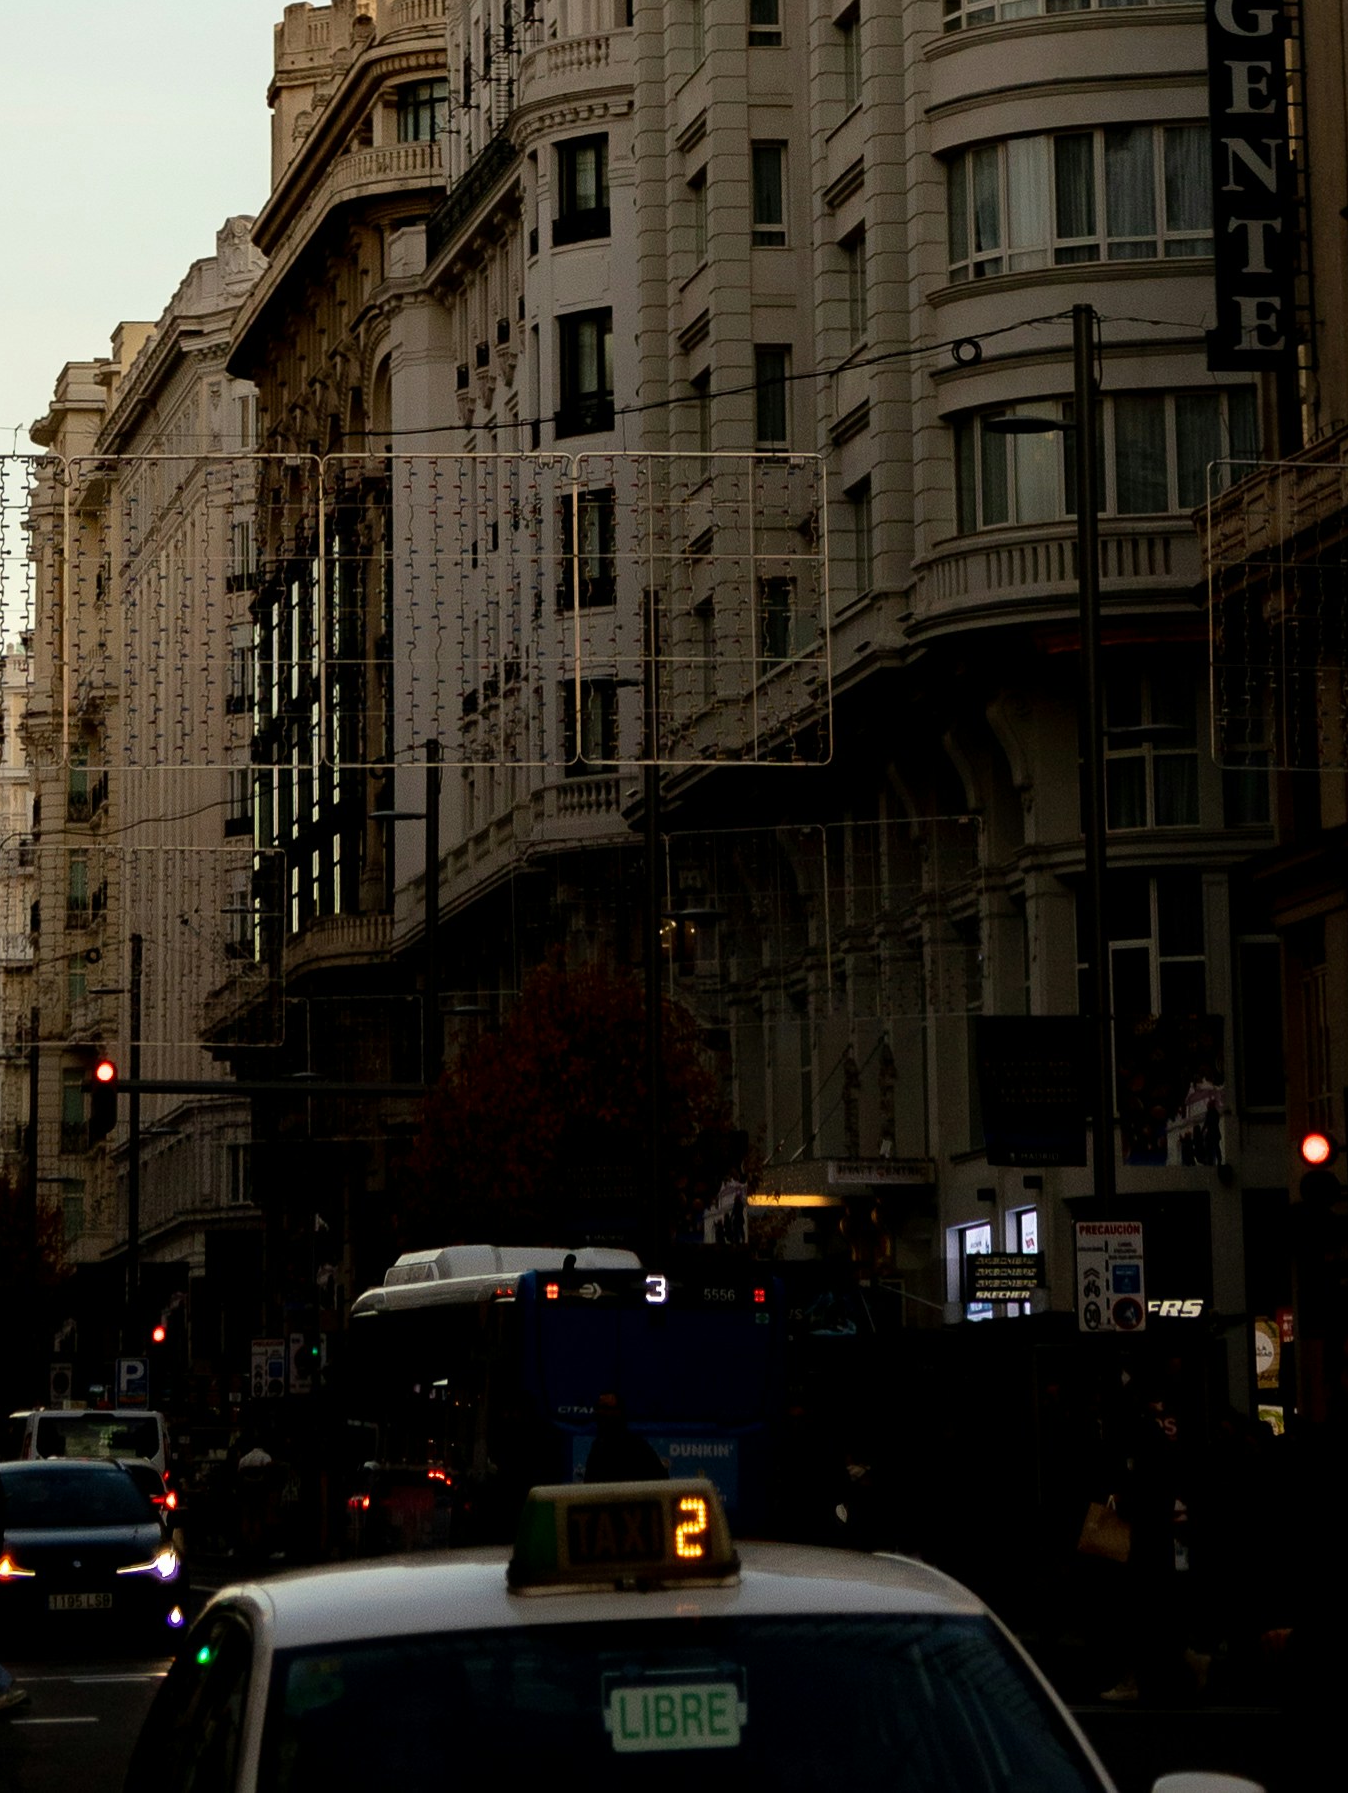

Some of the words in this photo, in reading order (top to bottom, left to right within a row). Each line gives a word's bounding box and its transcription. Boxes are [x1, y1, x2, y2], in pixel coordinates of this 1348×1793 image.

[1079, 1223, 1140, 1235] PRECAUCIÓN
[644, 1273, 668, 1303] 3
[703, 1287, 737, 1302] 5556
[975, 1290, 1031, 1300] SKECHER
[119, 1360, 145, 1391] P
[669, 1443, 733, 1458] DUNKIN'
[570, 1506, 661, 1557] TAXI
[675, 1498, 707, 1557] 2
[54, 1595, 83, 1609] 1195
[619, 1690, 731, 1741] LIBRE
